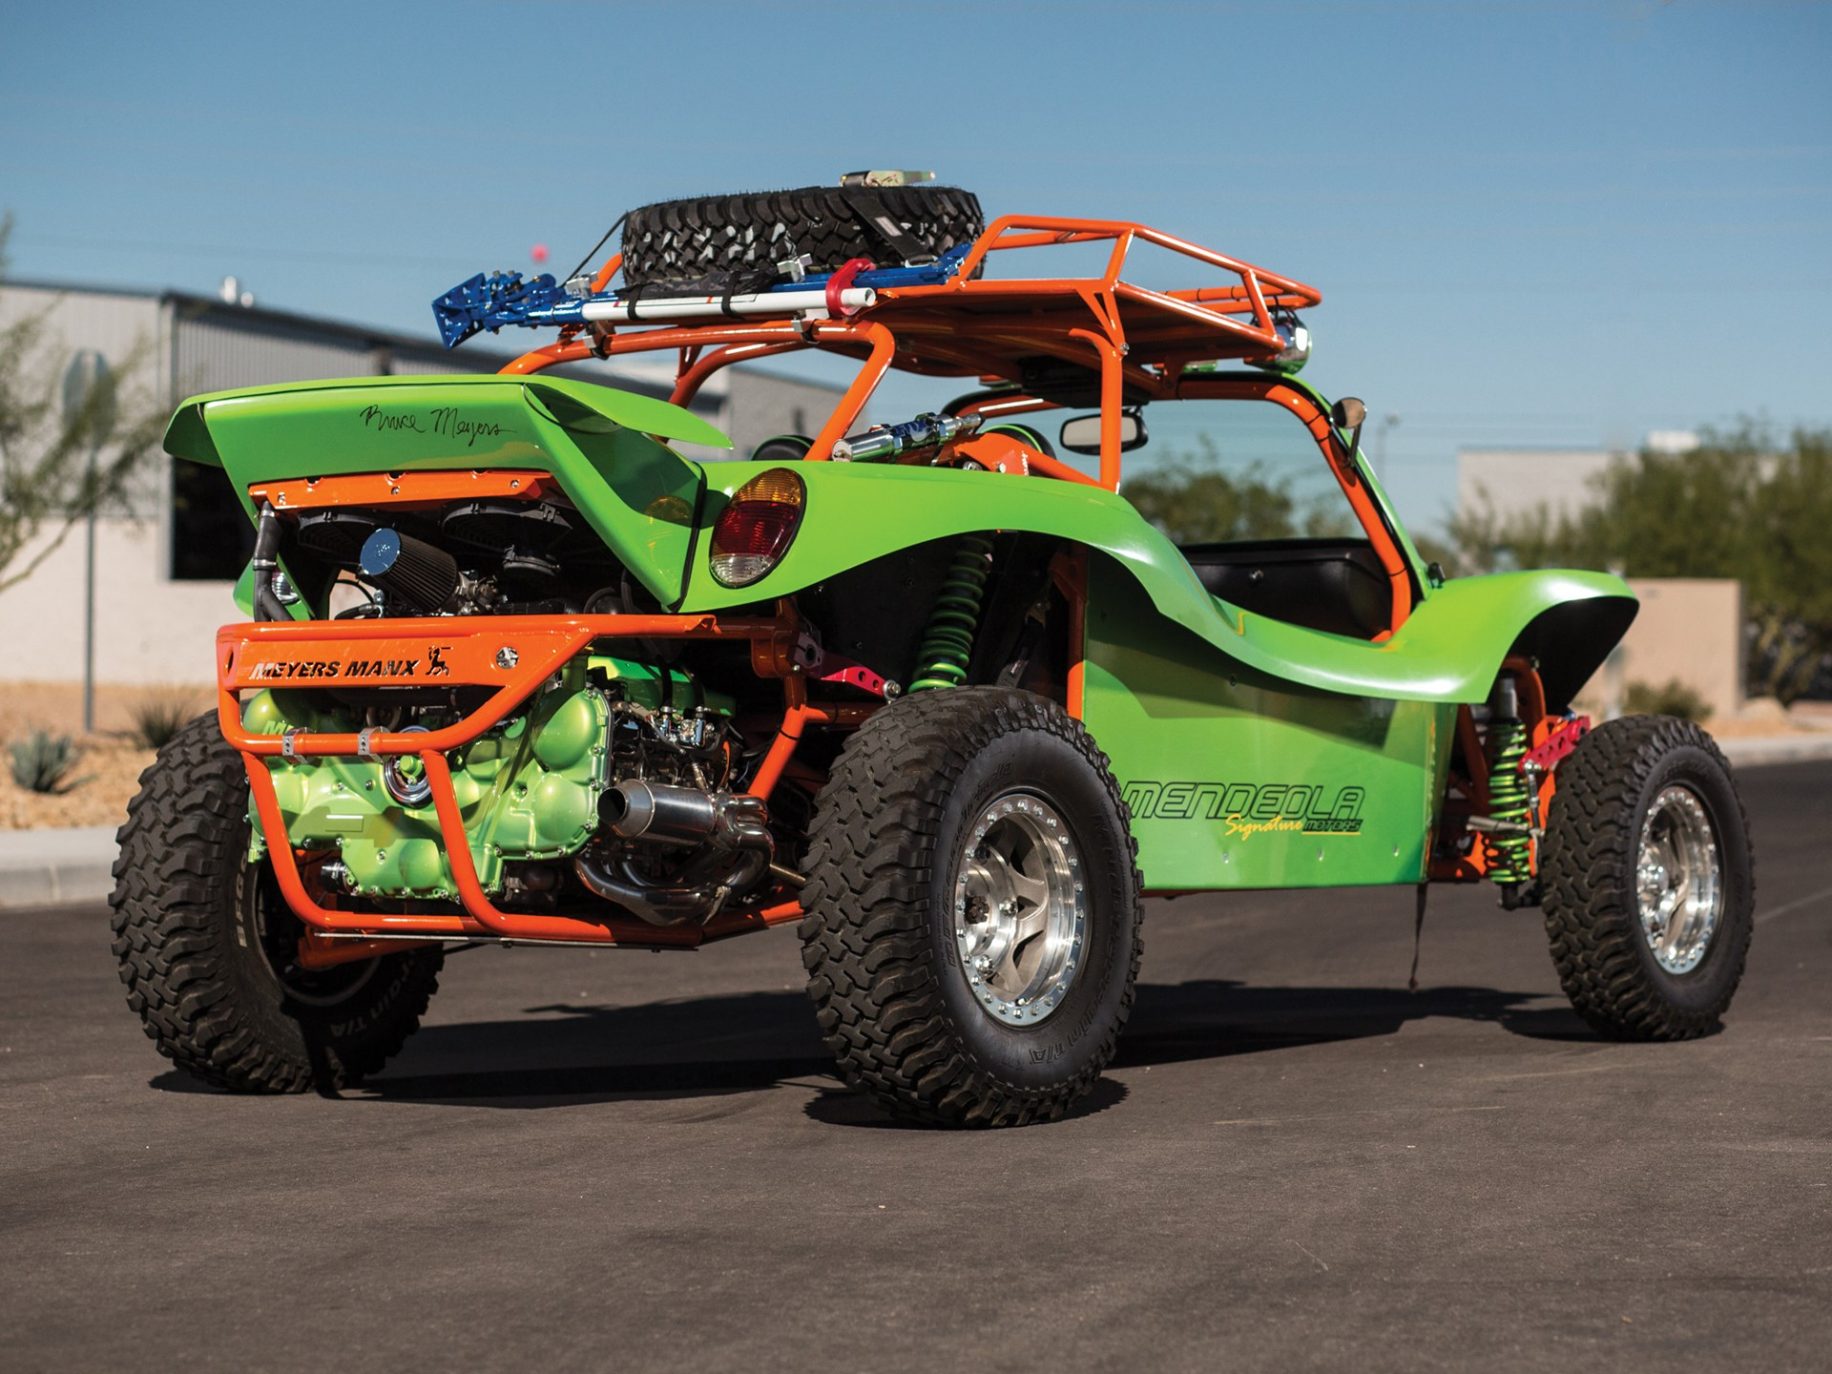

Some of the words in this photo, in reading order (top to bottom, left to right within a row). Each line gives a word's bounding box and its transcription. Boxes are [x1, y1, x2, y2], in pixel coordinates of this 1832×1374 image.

[430, 407, 518, 447] Meyers
[249, 660, 341, 680] MEYERS
[345, 659, 420, 677] MANX
[1120, 781, 1366, 820] MENDEOLA
[1225, 813, 1304, 841] Signature
[1303, 819, 1364, 832] MOTORS
